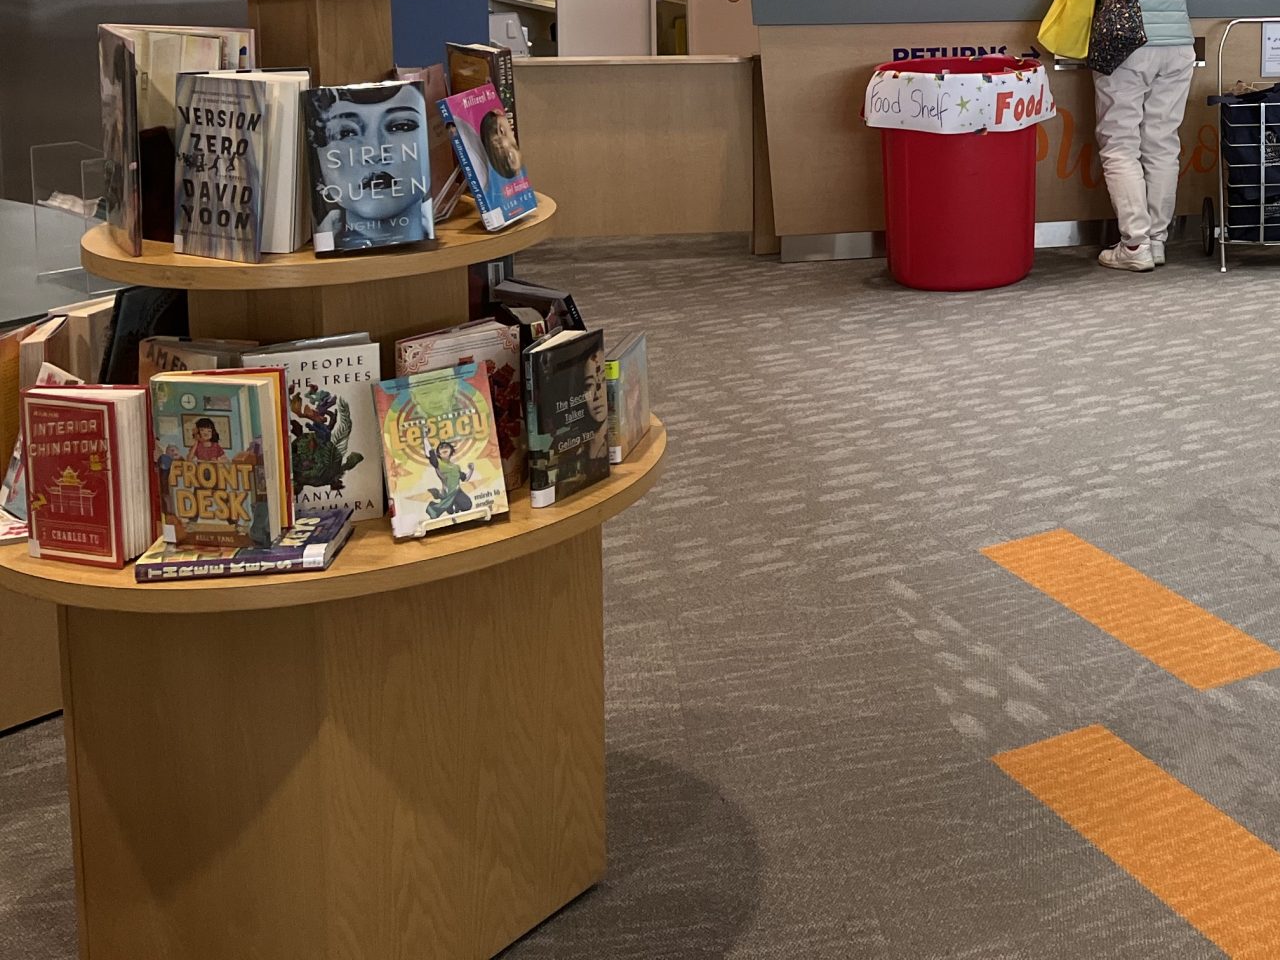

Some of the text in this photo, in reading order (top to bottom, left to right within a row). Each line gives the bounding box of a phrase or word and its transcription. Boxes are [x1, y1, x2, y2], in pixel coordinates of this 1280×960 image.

[870, 80, 951, 128] Food Shelf
[994, 83, 1044, 126] Food
[178, 106, 261, 131] VERSION
[190, 133, 249, 156] ZERO
[327, 142, 418, 169] SIREN
[183, 179, 254, 205] DAVID
[322, 176, 427, 203] QUEEN
[181, 205, 250, 230] YOON
[345, 217, 410, 232] NGHI VO
[301, 355, 364, 371] PEOPLE
[323, 371, 371, 385] TREES
[556, 400, 569, 410] The
[565, 409, 585, 422] Talker
[33, 420, 98, 437] INTERIOR
[389, 411, 489, 451] Legacy
[28, 439, 109, 457] CHINATOWN
[558, 431, 595, 451] Geling Yan
[168, 461, 253, 491] FRONT
[176, 489, 251, 521] DESK
[51, 530, 88, 544] CHARLES
[196, 534, 235, 543] KELLY YANG
[148, 563, 224, 578] THREE
[230, 559, 292, 573] KEYS
